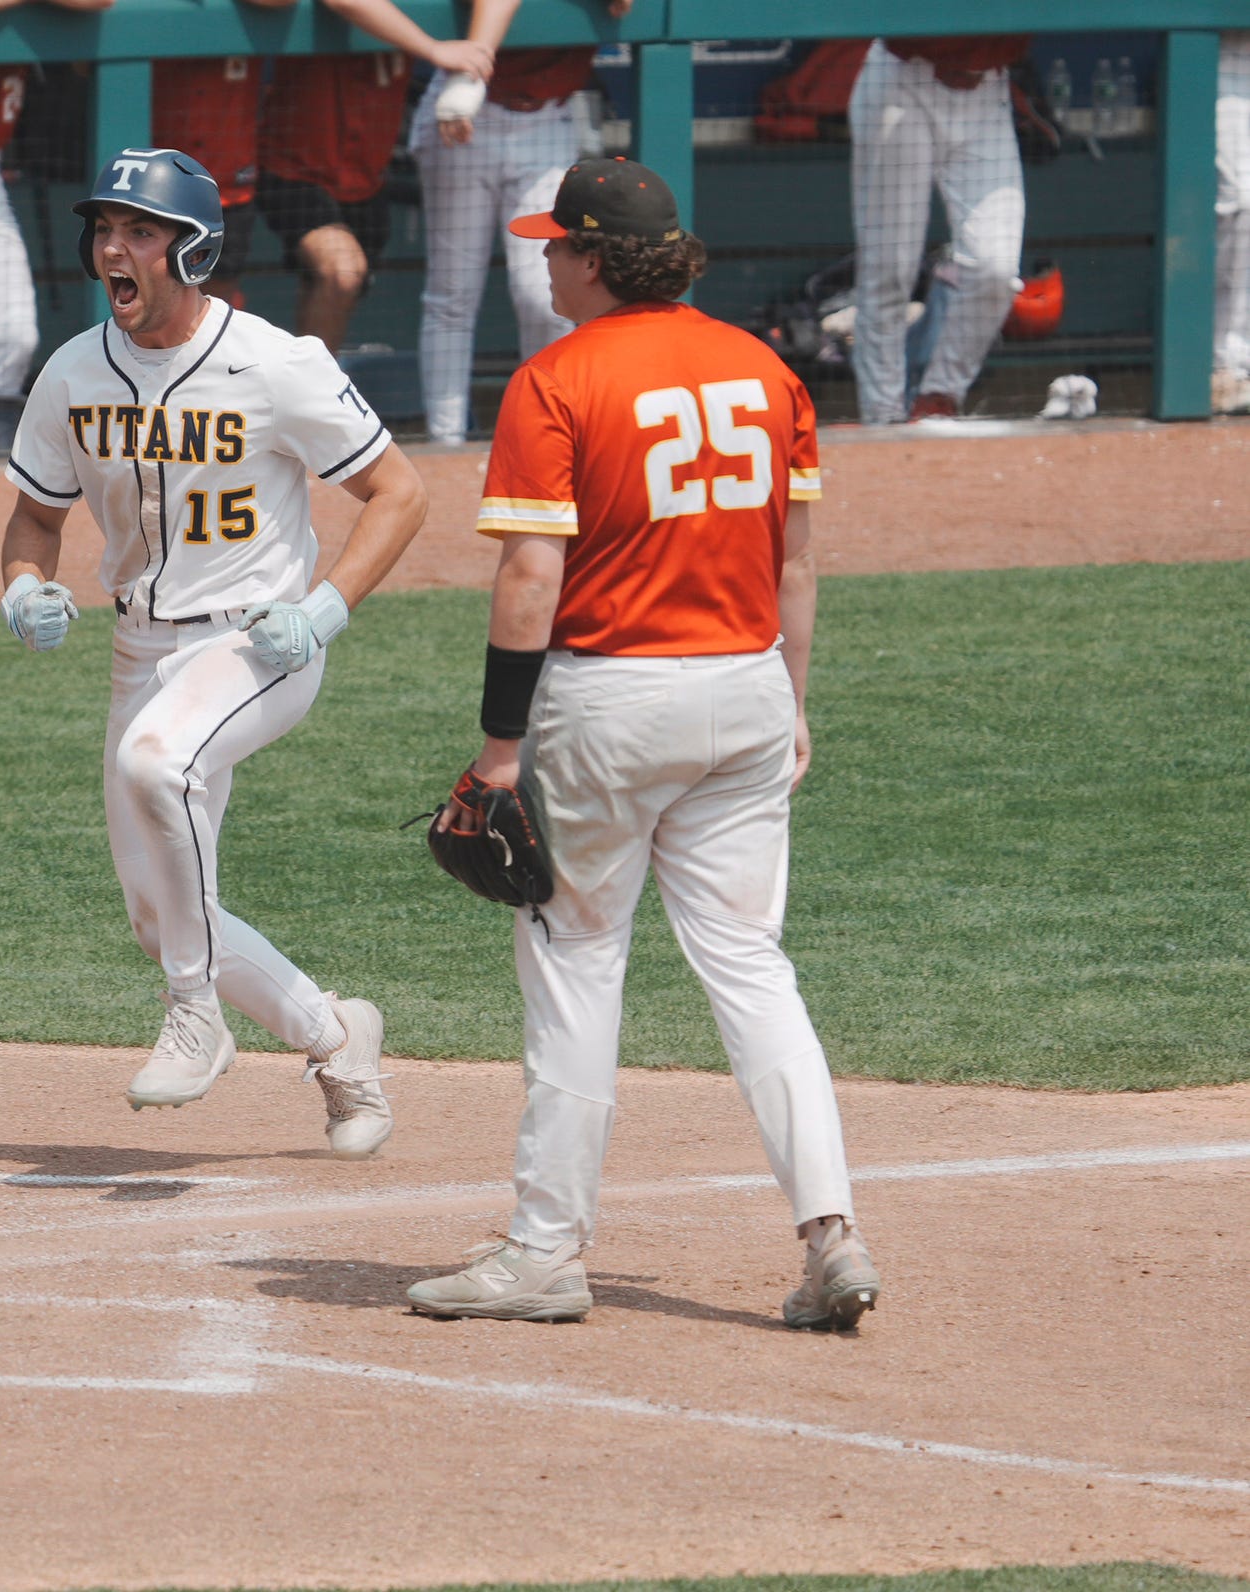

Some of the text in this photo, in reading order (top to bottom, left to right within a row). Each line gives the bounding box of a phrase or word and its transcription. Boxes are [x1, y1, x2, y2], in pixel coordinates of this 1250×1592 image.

[112, 159, 149, 191] T
[68, 403, 247, 466] TITANS
[634, 378, 773, 523] 25
[183, 483, 260, 546] 15
